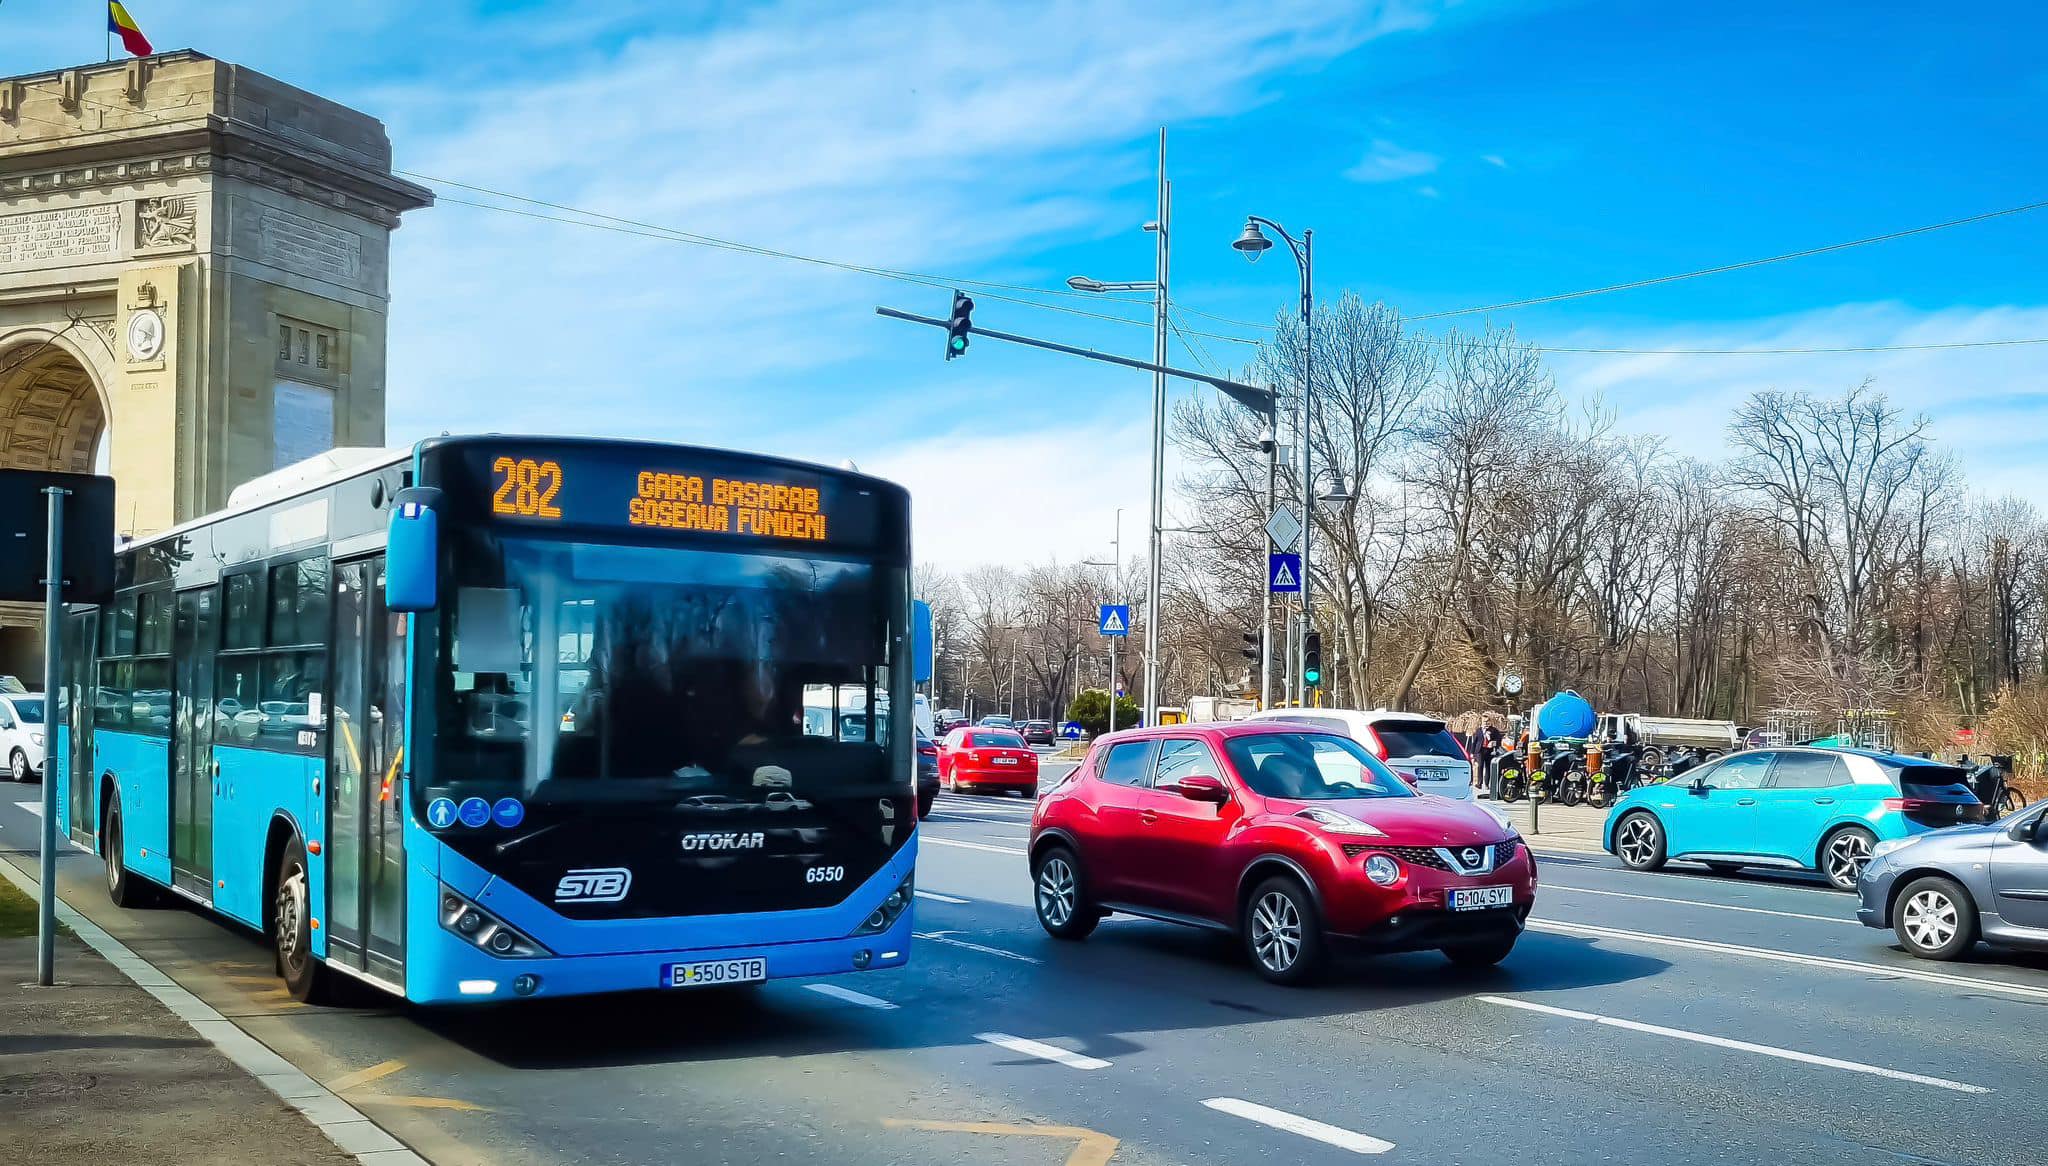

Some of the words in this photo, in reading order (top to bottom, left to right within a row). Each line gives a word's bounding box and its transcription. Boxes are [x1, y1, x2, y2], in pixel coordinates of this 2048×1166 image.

[493, 456, 563, 518] 282
[638, 471, 704, 502] GARA
[712, 478, 819, 513] BASARAB
[629, 498, 728, 531] SOSEAUA
[737, 508, 826, 540] FUNDENI
[681, 832, 764, 850] OTOKAR
[555, 872, 628, 900] STB
[806, 866, 844, 883] 6550
[1456, 892, 1465, 906] B
[1468, 890, 1485, 905] 104
[1488, 888, 1507, 903] SYI
[673, 965, 686, 984] B
[692, 964, 724, 982] 550
[727, 960, 762, 979] STB
